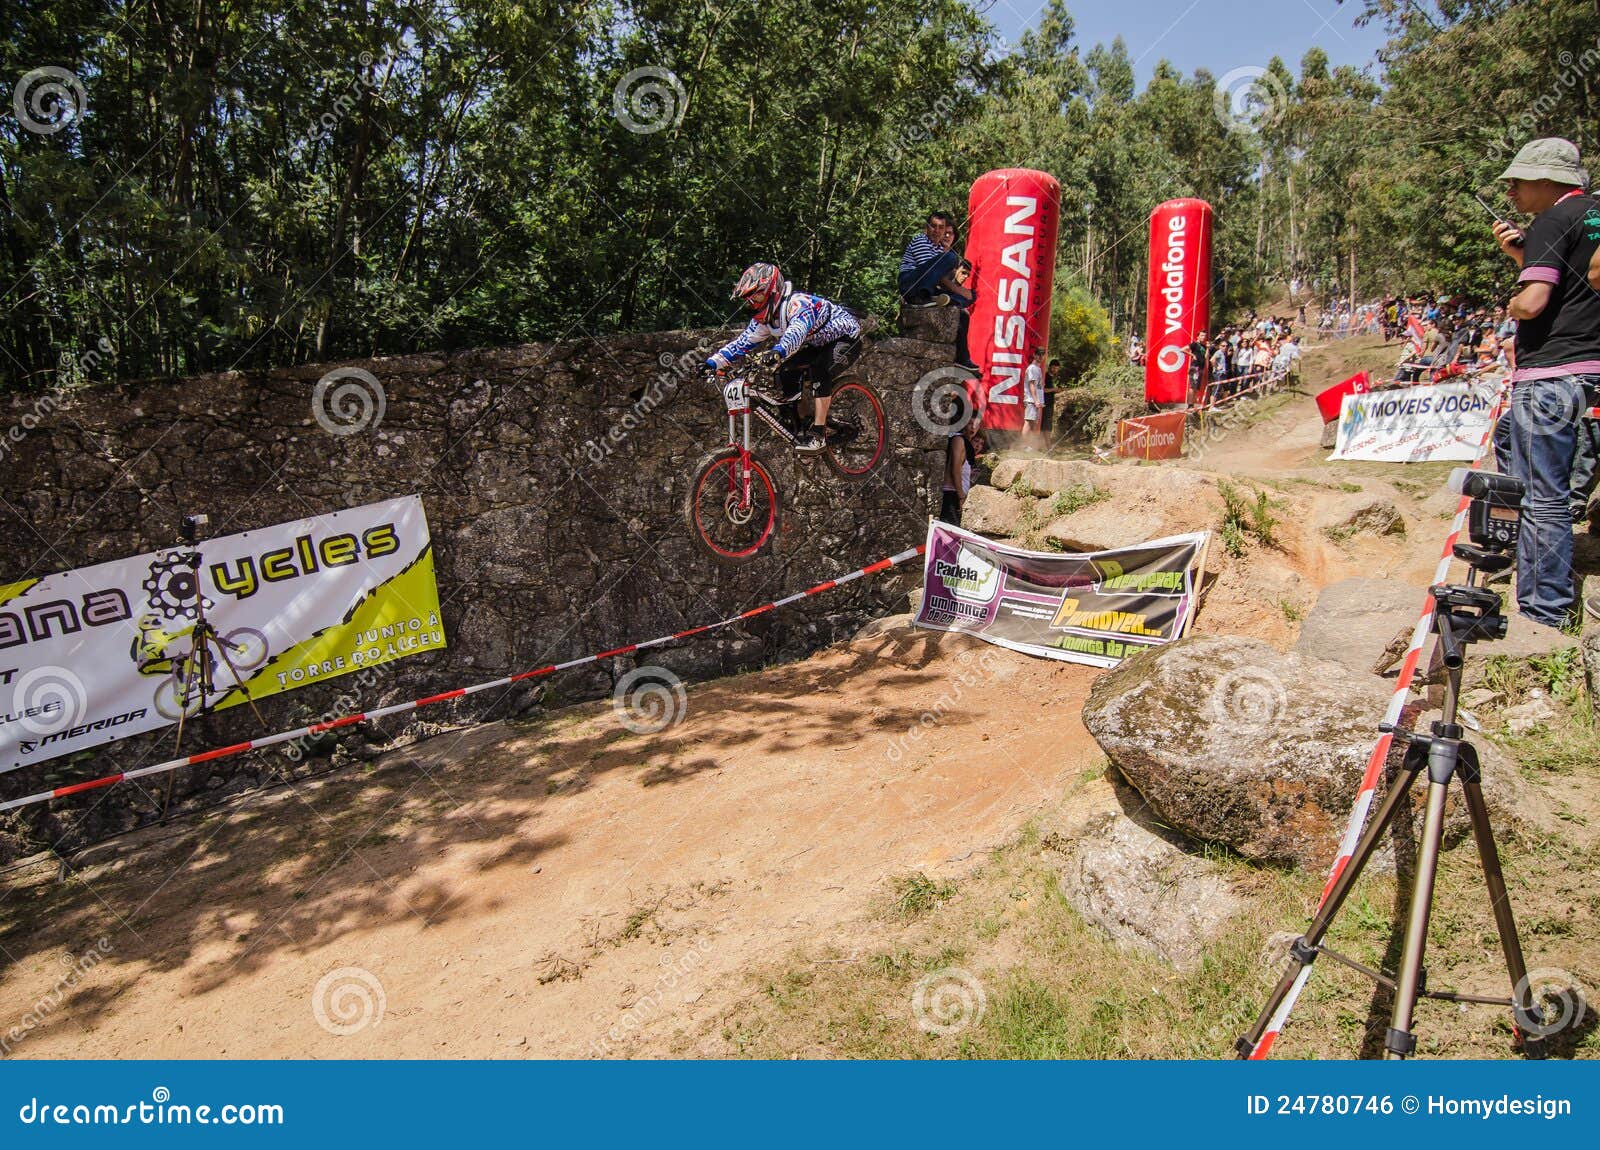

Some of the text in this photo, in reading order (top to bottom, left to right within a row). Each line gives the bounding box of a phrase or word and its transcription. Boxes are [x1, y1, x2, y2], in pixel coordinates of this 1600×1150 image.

[1033, 201, 1049, 318] ADVENTURE
[1162, 215, 1186, 335] vodafone
[988, 196, 1037, 405] NISSAN
[728, 387, 740, 400] 42
[1371, 398, 1432, 418] MOVEIS
[1137, 429, 1175, 448] voafone
[935, 560, 978, 581] Padela
[943, 576, 980, 592] NATURAL
[930, 596, 948, 610] um
[356, 618, 421, 646] JUNTO
[277, 631, 442, 686] TORRE DO LICEU
[40, 708, 148, 746] MERIDA
